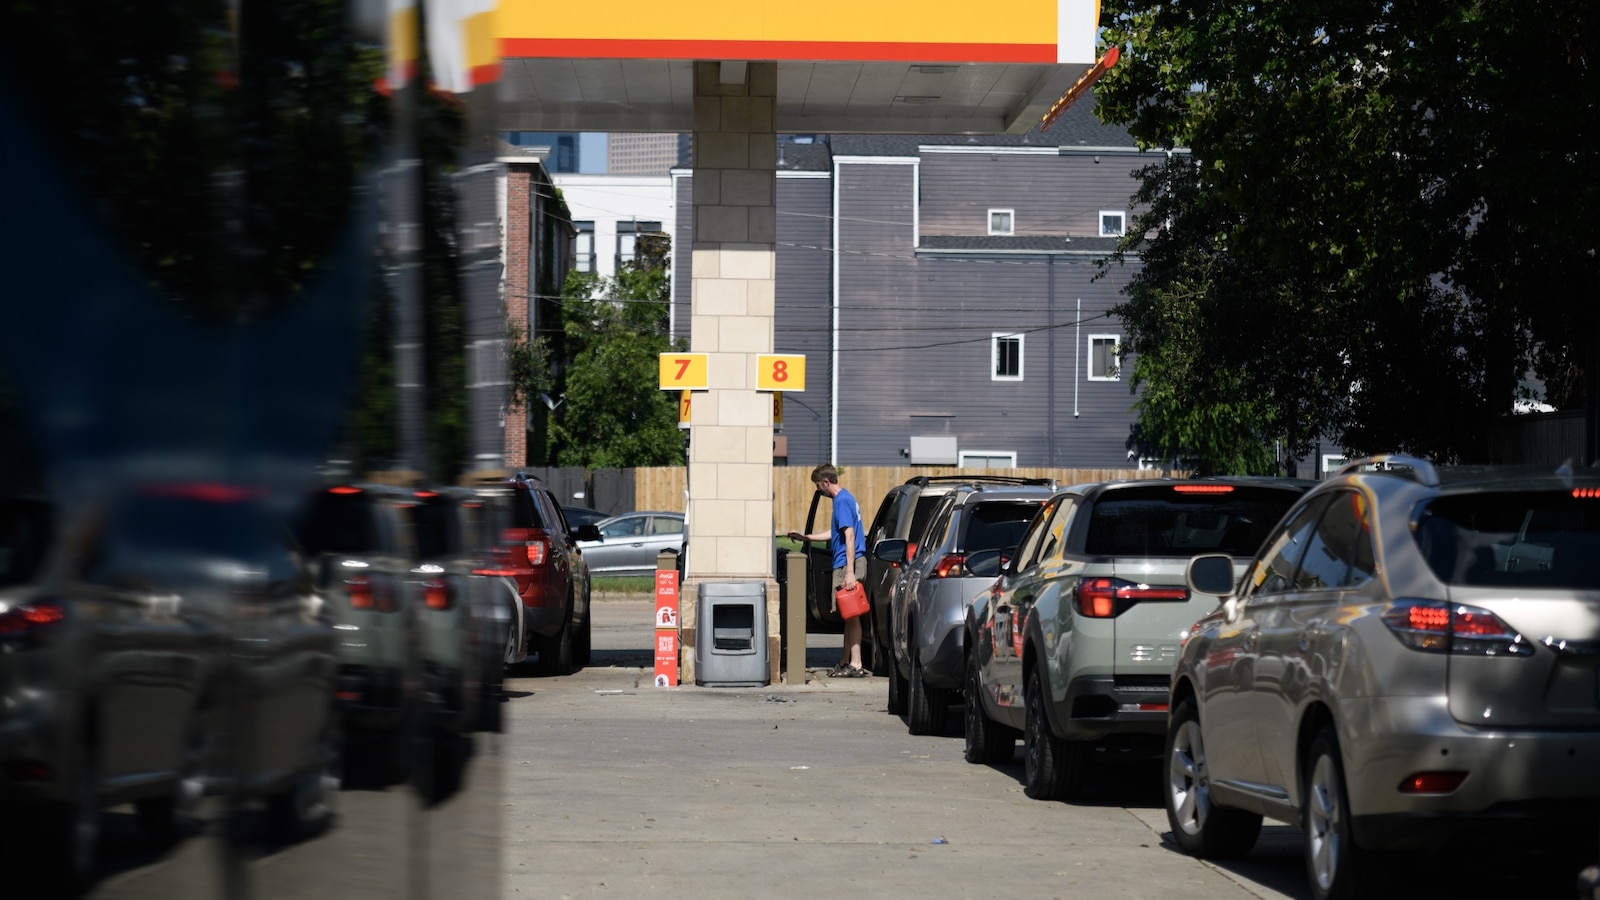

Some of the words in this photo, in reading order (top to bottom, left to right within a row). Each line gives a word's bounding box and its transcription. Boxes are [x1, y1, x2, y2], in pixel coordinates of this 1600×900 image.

[674, 359, 692, 381] 7
[772, 360, 789, 383] 8
[684, 399, 691, 416] 7
